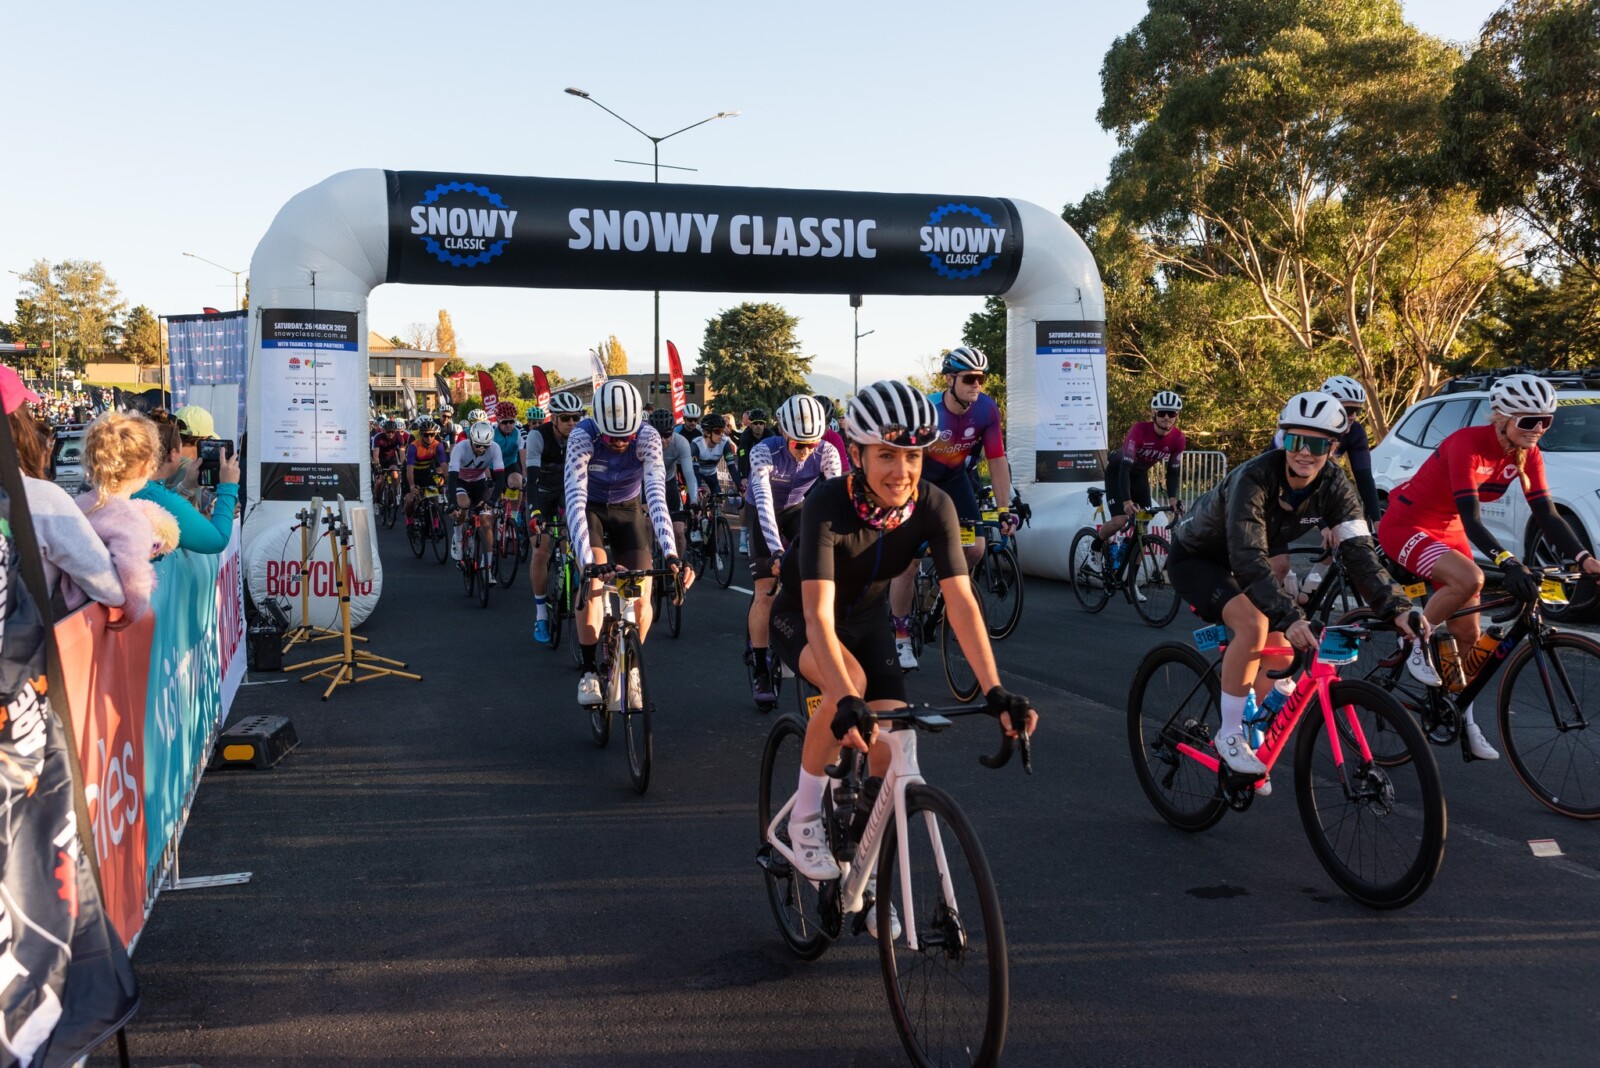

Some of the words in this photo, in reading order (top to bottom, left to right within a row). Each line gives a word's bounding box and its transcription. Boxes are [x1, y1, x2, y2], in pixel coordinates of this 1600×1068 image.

[410, 205, 518, 238] SNOWY
[568, 208, 719, 253] SNOWY
[729, 214, 877, 258] CLASSIC
[444, 237, 486, 250] CLASSIC
[919, 226, 1006, 254] SNOWY
[945, 253, 979, 265] CLASSIC
[274, 322, 303, 330] SATURDAY,
[333, 324, 347, 332] 2022
[274, 330, 347, 339] snowyclassic.com.au
[1399, 533, 1425, 565] BLACK
[266, 560, 373, 597] BICYCLN
[1264, 685, 1304, 752] FACTOR
